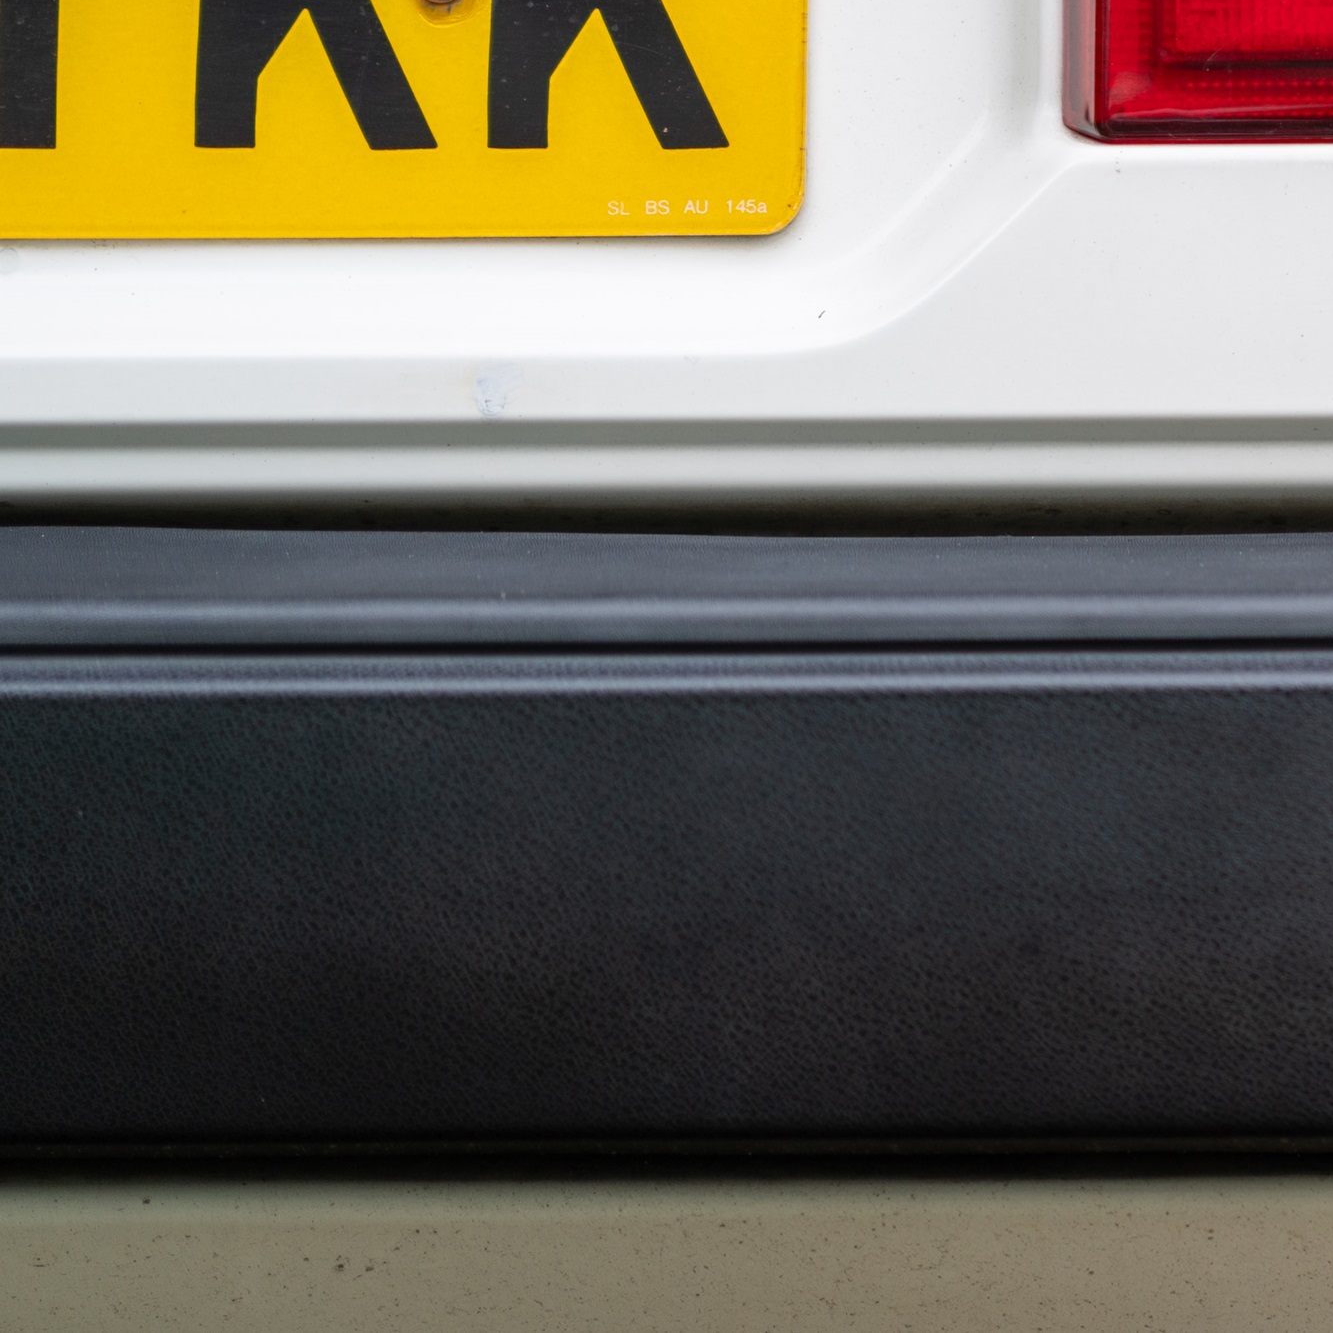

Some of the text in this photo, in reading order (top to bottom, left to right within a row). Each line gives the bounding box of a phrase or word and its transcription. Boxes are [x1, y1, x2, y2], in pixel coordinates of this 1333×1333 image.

[607, 199, 767, 215] SL BS AU 145a
